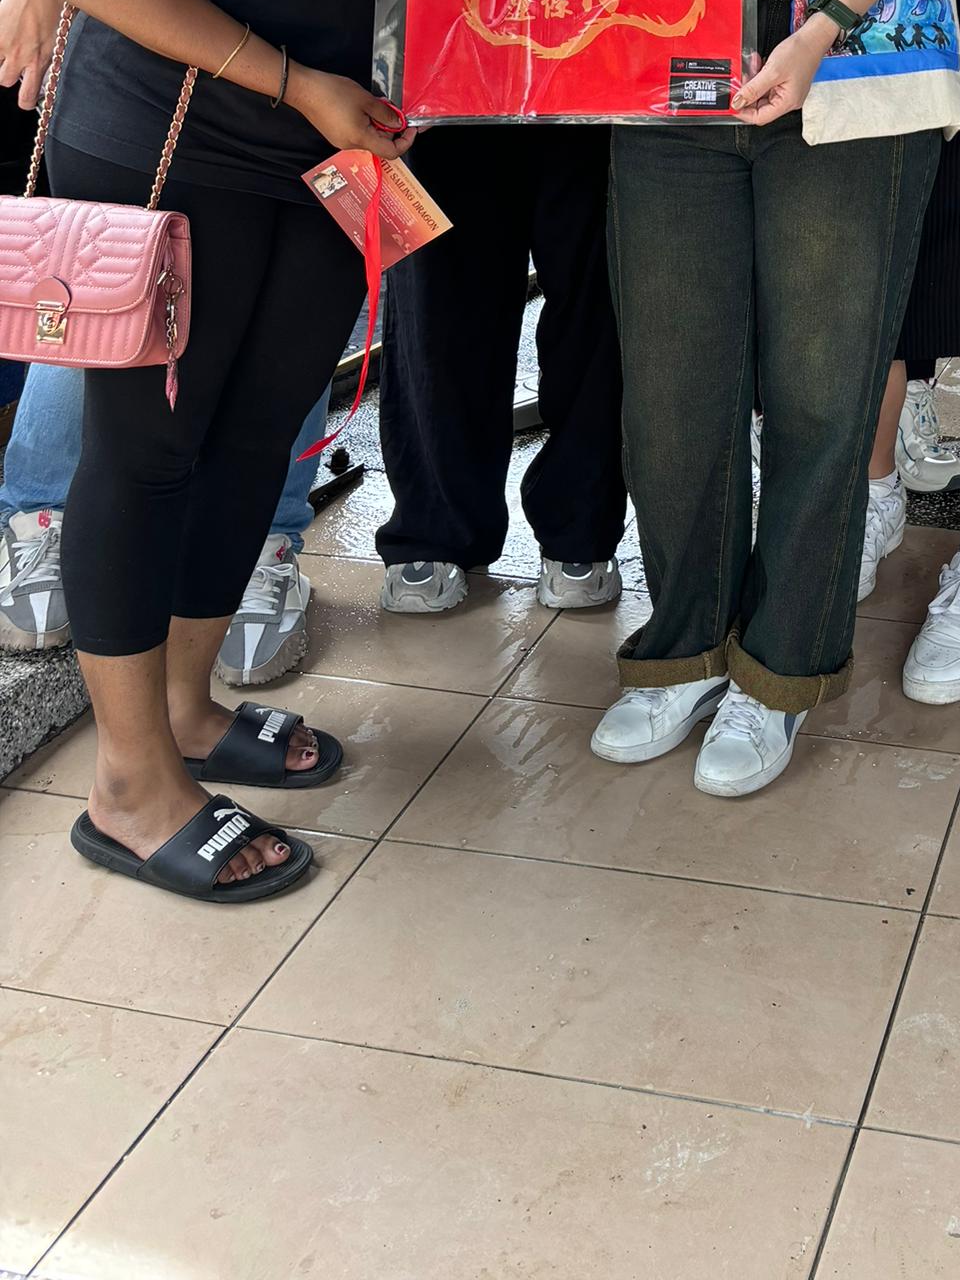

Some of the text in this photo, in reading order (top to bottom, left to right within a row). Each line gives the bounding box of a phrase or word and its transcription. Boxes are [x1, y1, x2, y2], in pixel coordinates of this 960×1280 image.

[684, 80, 716, 90] CREATIVE
[390, 173, 416, 202] SAILING
[412, 201, 440, 232] DRAGON
[257, 710, 288, 744] PUMA
[196, 815, 250, 862] PUMA
